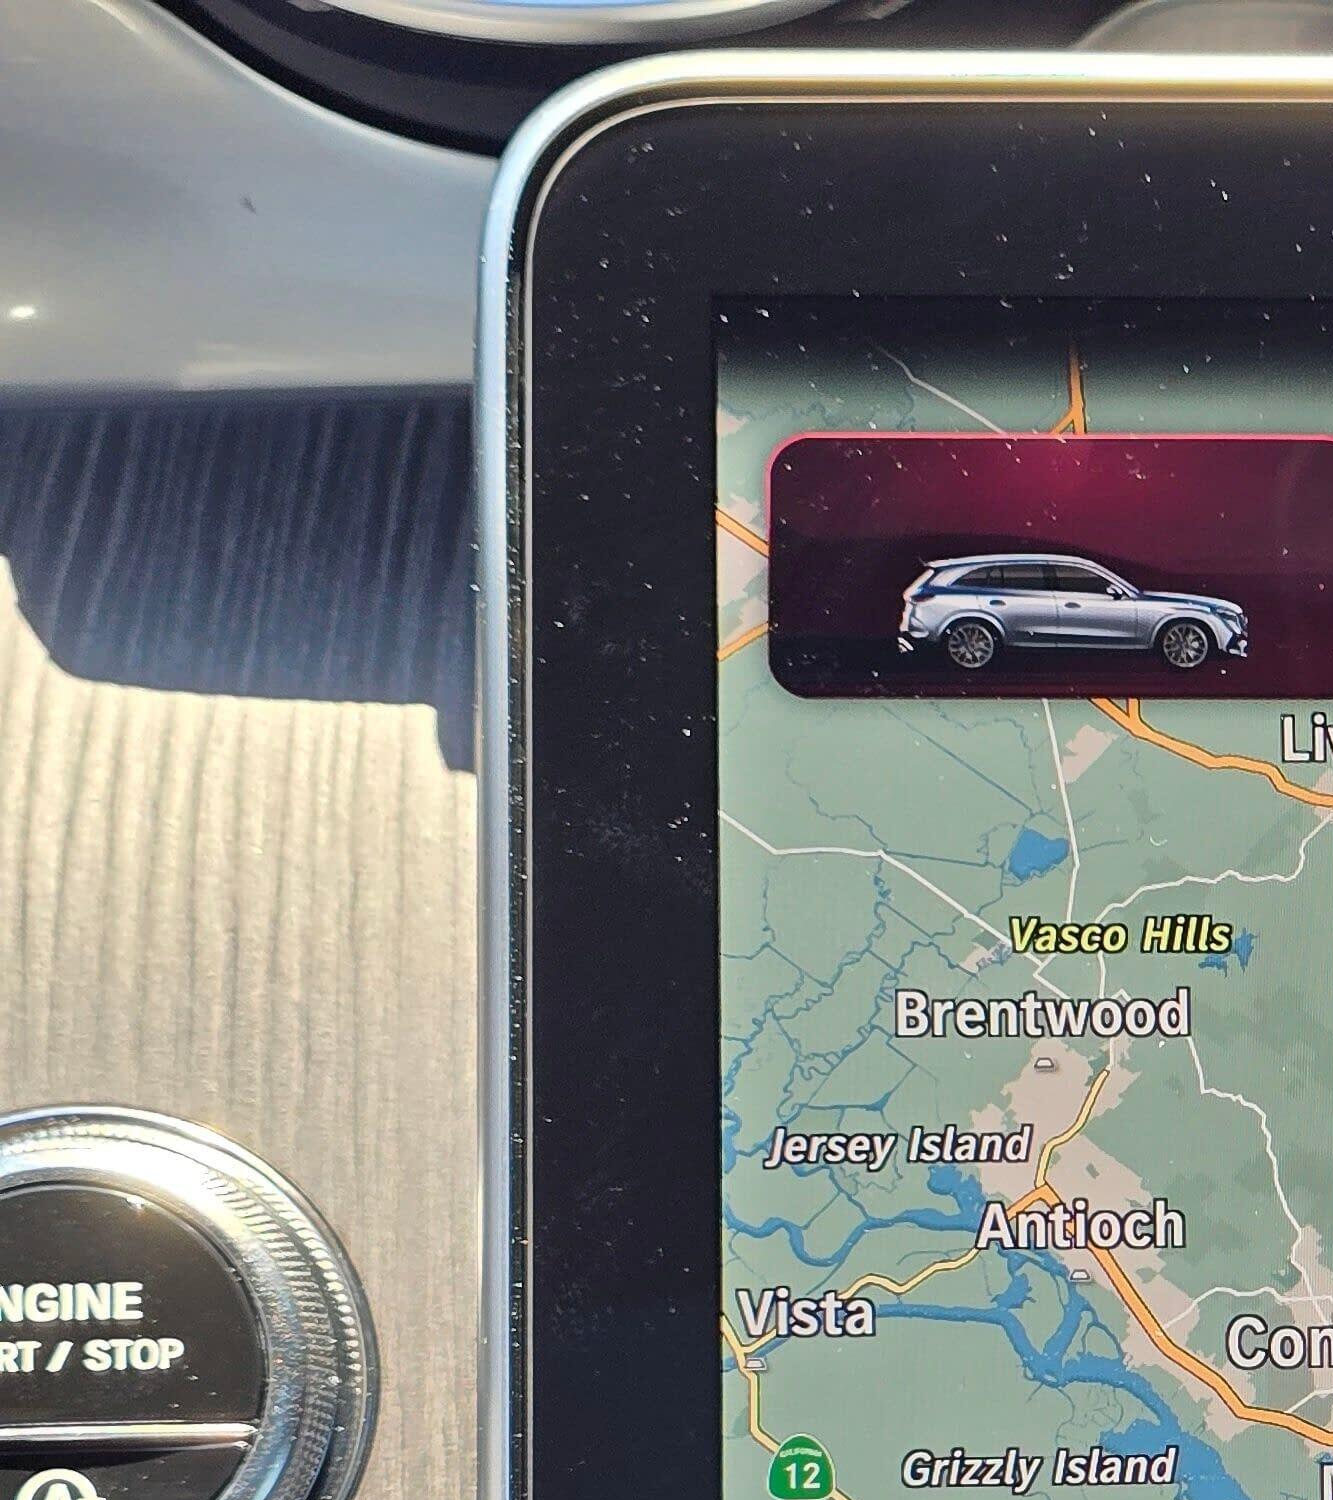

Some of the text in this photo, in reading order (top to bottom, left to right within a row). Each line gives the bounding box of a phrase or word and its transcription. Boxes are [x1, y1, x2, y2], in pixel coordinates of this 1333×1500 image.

[1011, 915, 1232, 953] Vasco Hills
[896, 988, 1191, 1038] Brentwood
[766, 1126, 1032, 1170] Jersey Island
[976, 1200, 1185, 1249] Antioch
[0, 1281, 144, 1323] NGINE
[738, 1288, 876, 1337] Vista
[82, 1337, 185, 1373] STOP
[782, 1462, 822, 1490] 12
[902, 1448, 1178, 1493] Grizzly Island
